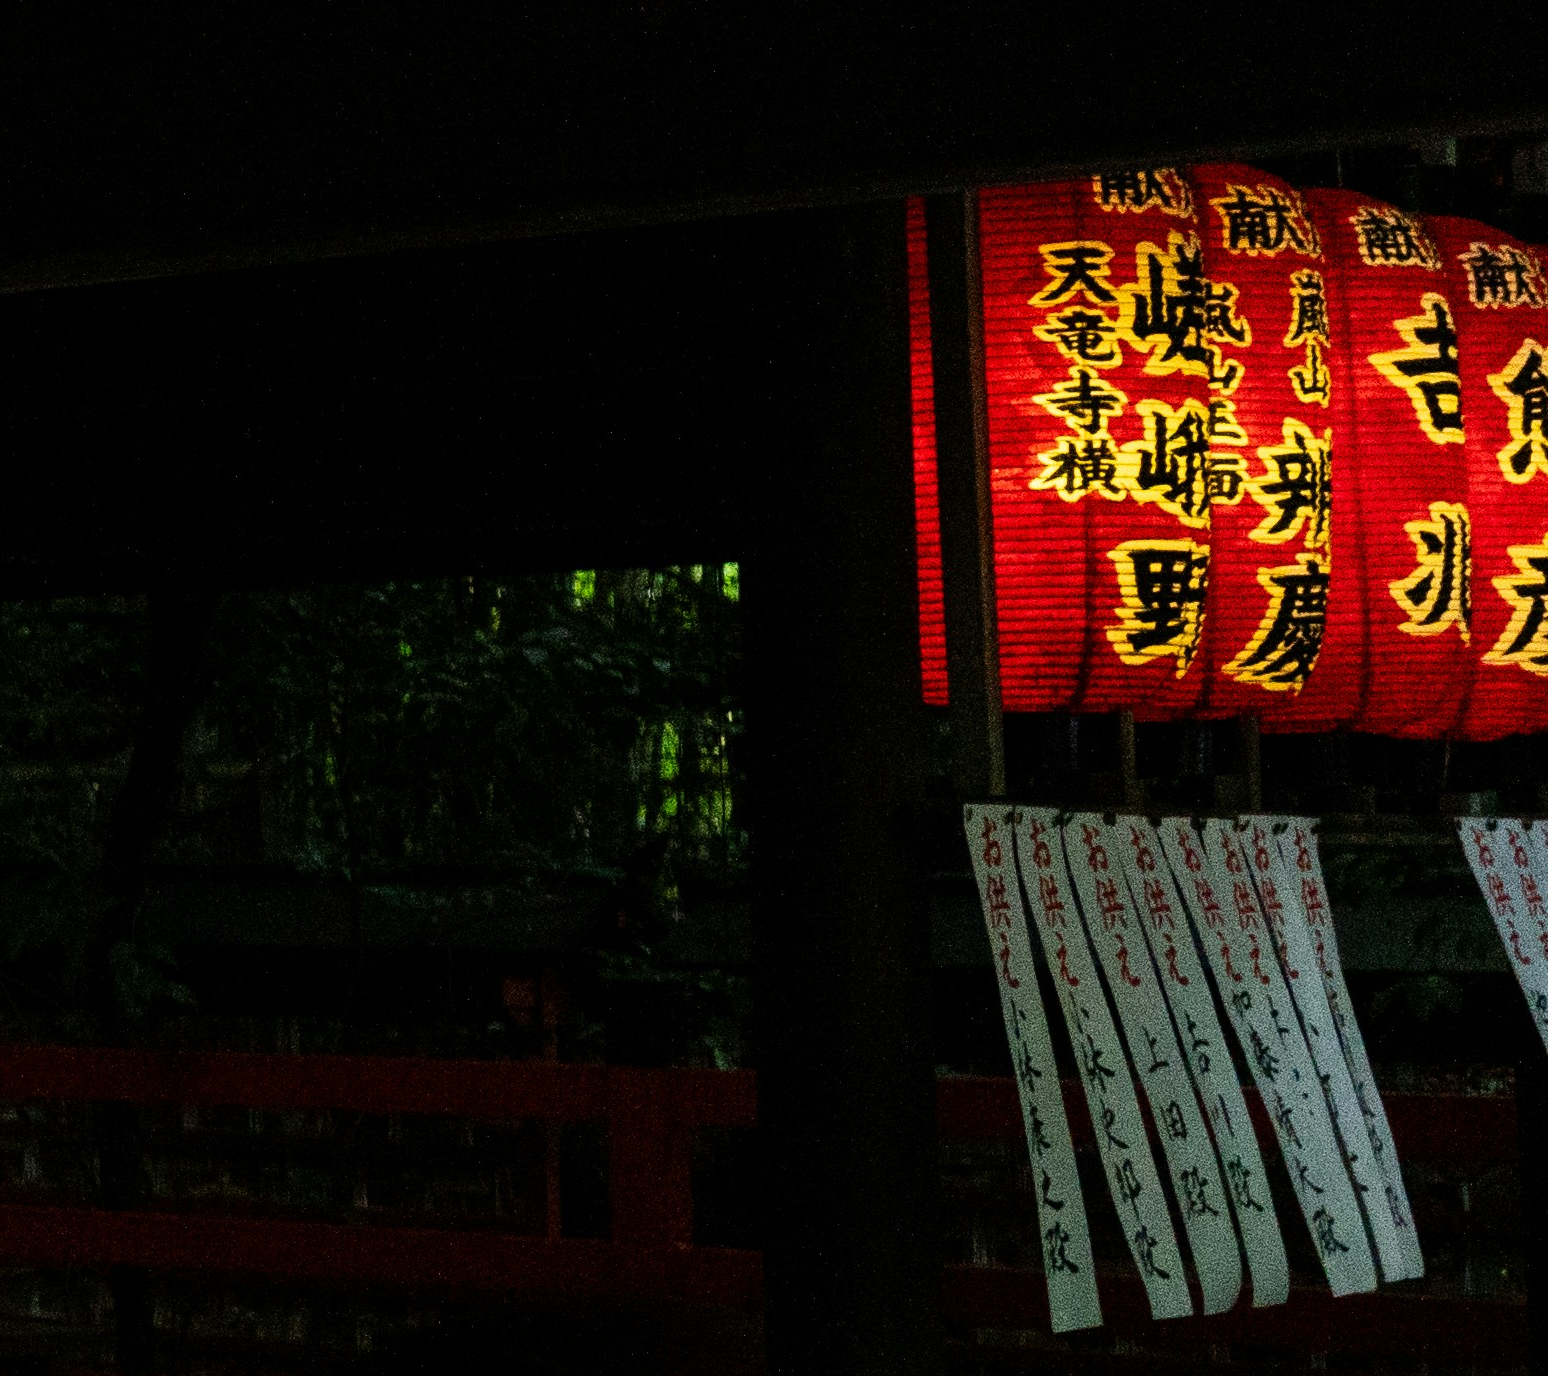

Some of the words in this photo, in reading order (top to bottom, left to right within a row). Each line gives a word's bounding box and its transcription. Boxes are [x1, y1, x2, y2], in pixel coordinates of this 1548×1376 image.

[1029, 239, 1128, 502] 天竜寺横
[1106, 229, 1212, 680] 嵯峨野
